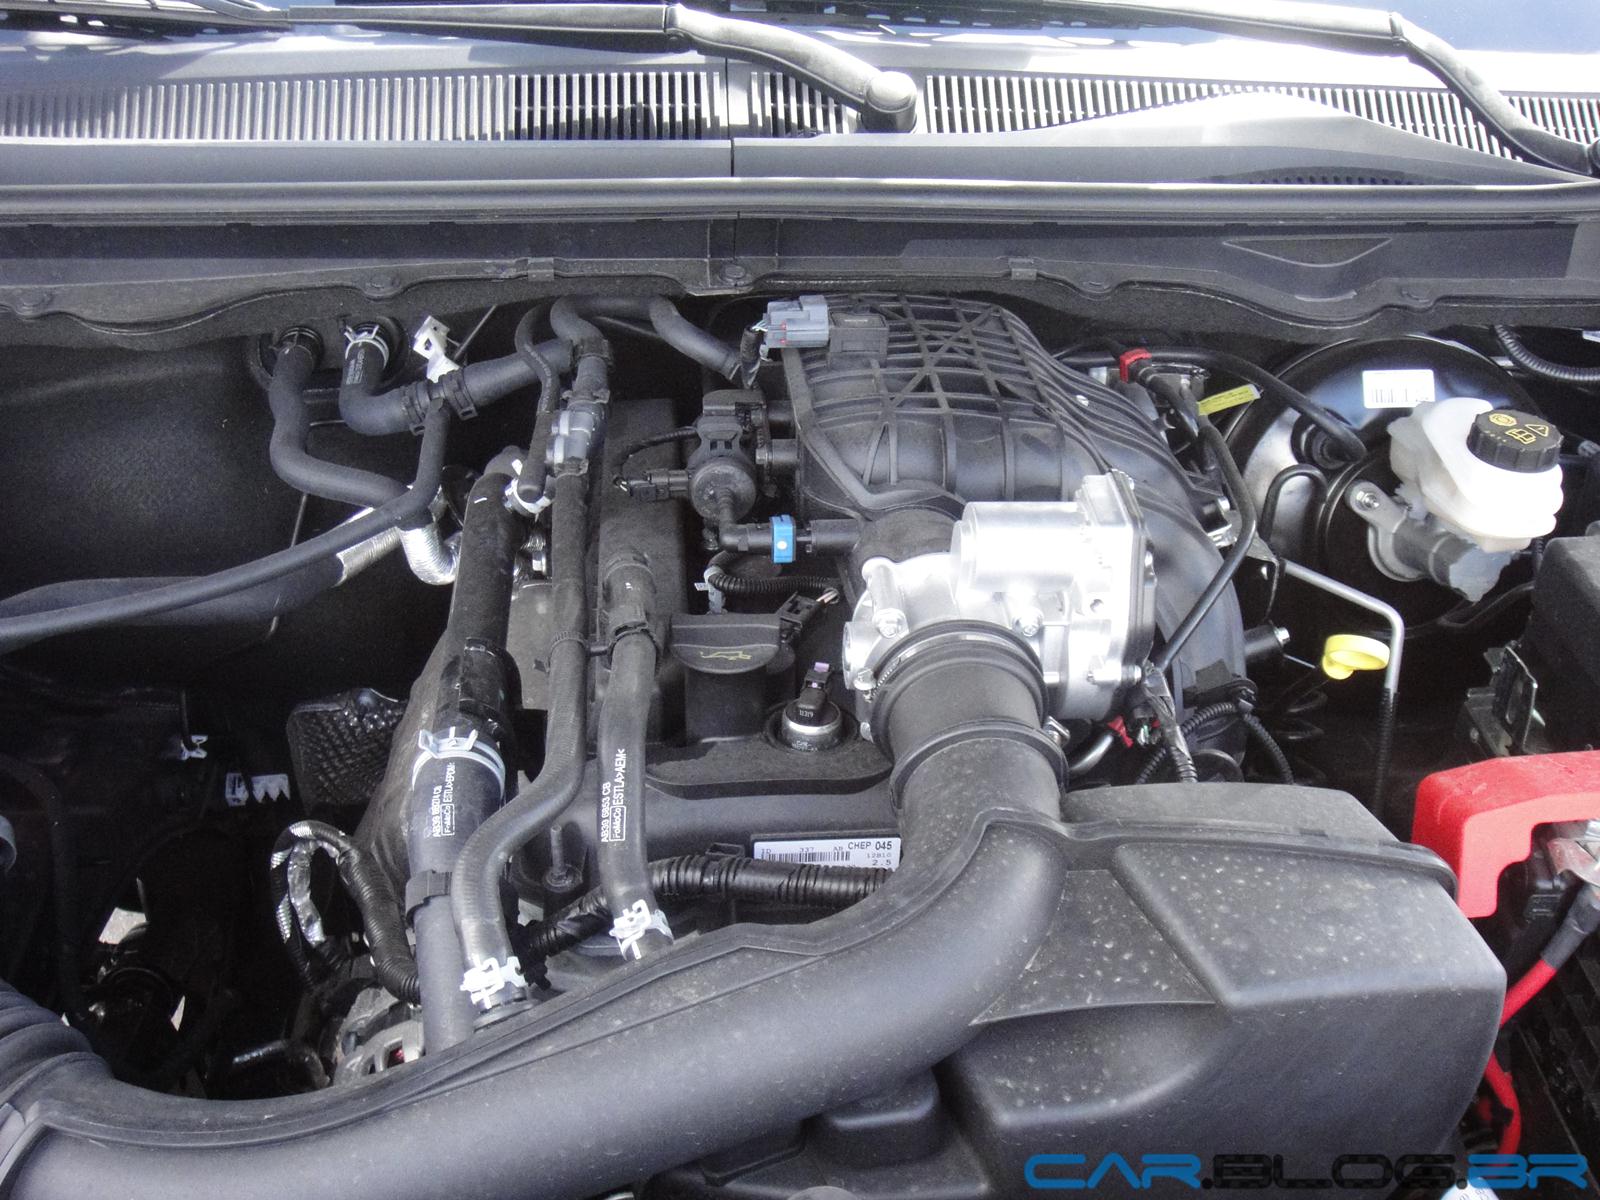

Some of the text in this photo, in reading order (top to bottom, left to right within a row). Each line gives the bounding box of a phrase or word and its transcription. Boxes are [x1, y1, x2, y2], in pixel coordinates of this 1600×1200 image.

[612, 807, 622, 839] FoMoCo
[847, 840, 893, 850] CHEP 045
